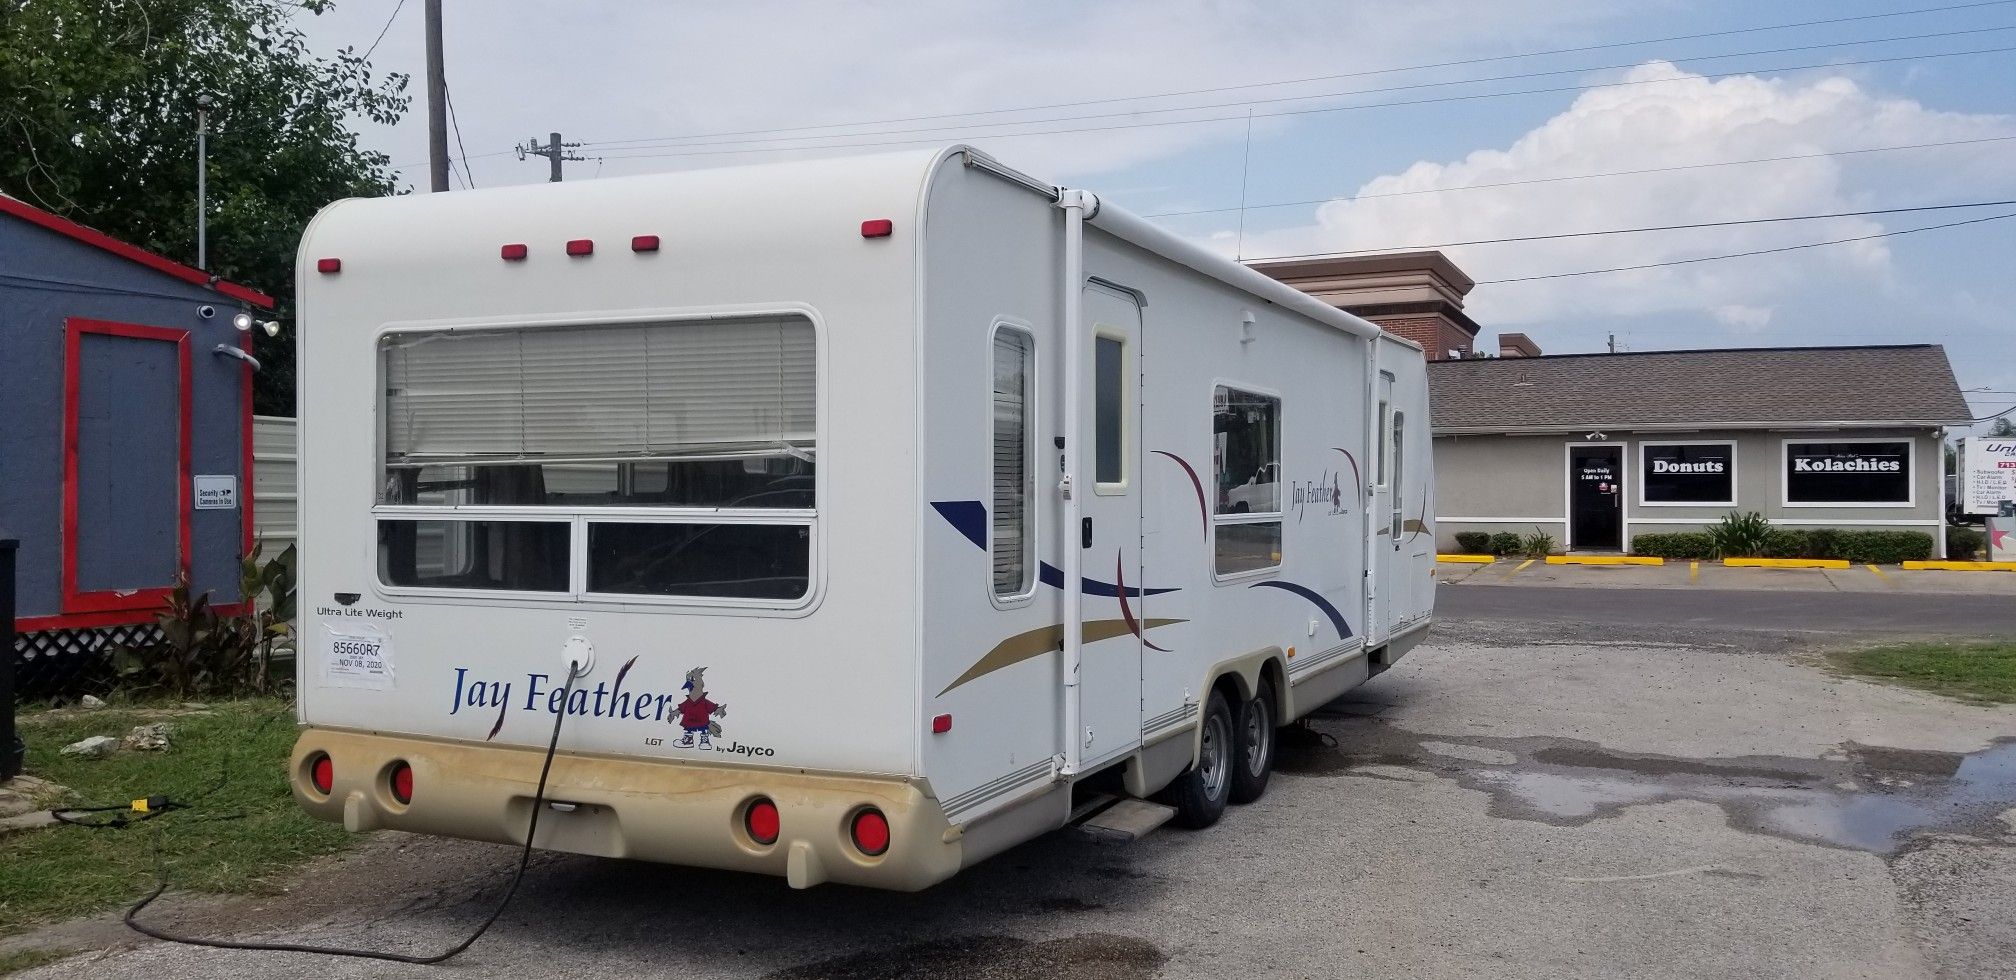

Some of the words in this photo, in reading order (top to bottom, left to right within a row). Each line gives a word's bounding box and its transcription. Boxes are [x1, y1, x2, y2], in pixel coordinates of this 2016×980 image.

[1653, 460, 1723, 473] Donuts
[1794, 458, 1900, 471] Kolachies
[1292, 481, 1305, 525] Jay
[1307, 468, 1333, 504] Feather
[317, 607, 342, 616] Ultra
[345, 608, 363, 617] Lite
[366, 608, 403, 620] Weight
[333, 641, 380, 656] 85660R7
[340, 659, 354, 667] NOV
[366, 661, 382, 669] 2020
[450, 667, 512, 742] Jay
[523, 655, 673, 721] Feather
[644, 737, 664, 746] LGT
[716, 745, 725, 753] by
[726, 741, 775, 757] Jayco
